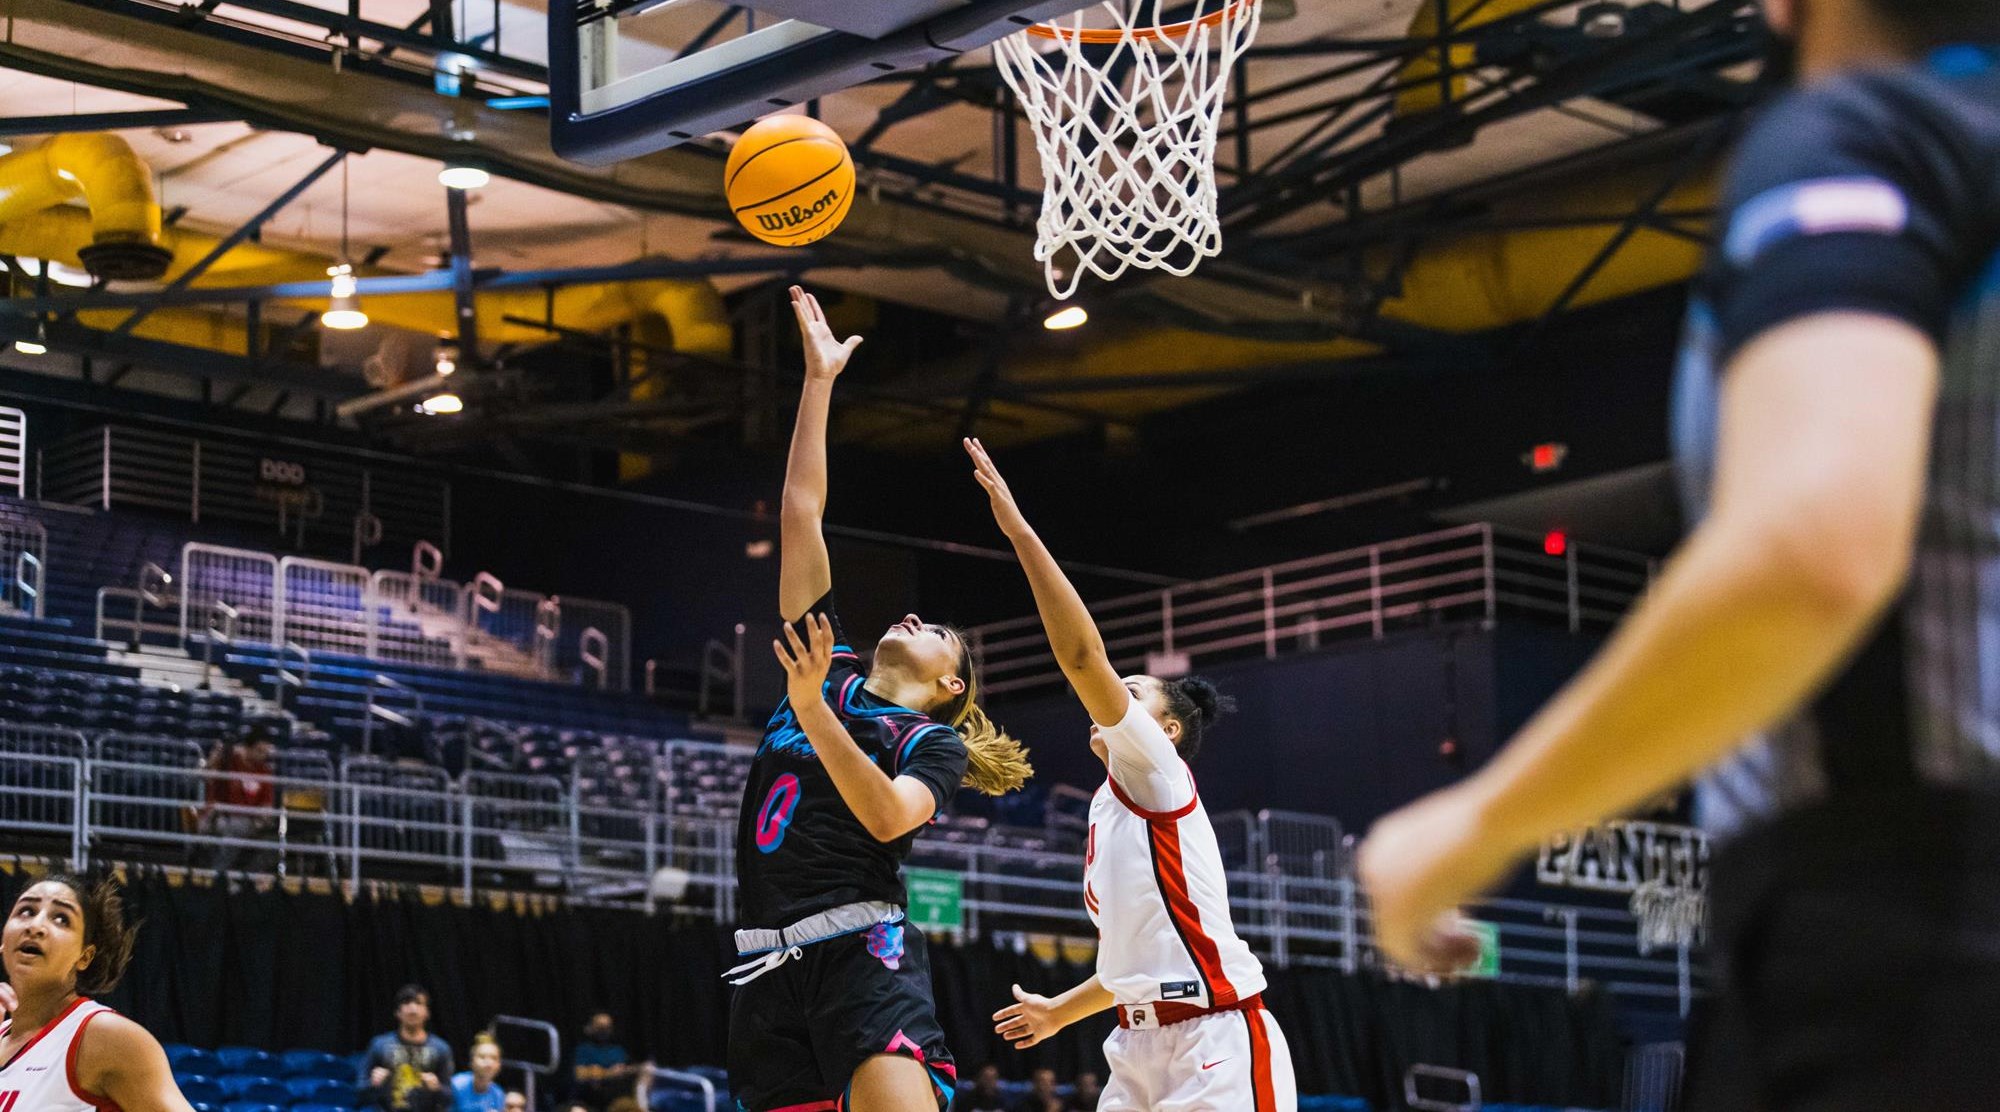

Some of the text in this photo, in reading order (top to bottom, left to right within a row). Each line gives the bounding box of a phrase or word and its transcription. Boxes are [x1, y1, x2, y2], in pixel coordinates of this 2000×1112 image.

[756, 189, 838, 231] Wilson
[756, 772, 801, 854] 0
[1187, 984, 1195, 993] M
